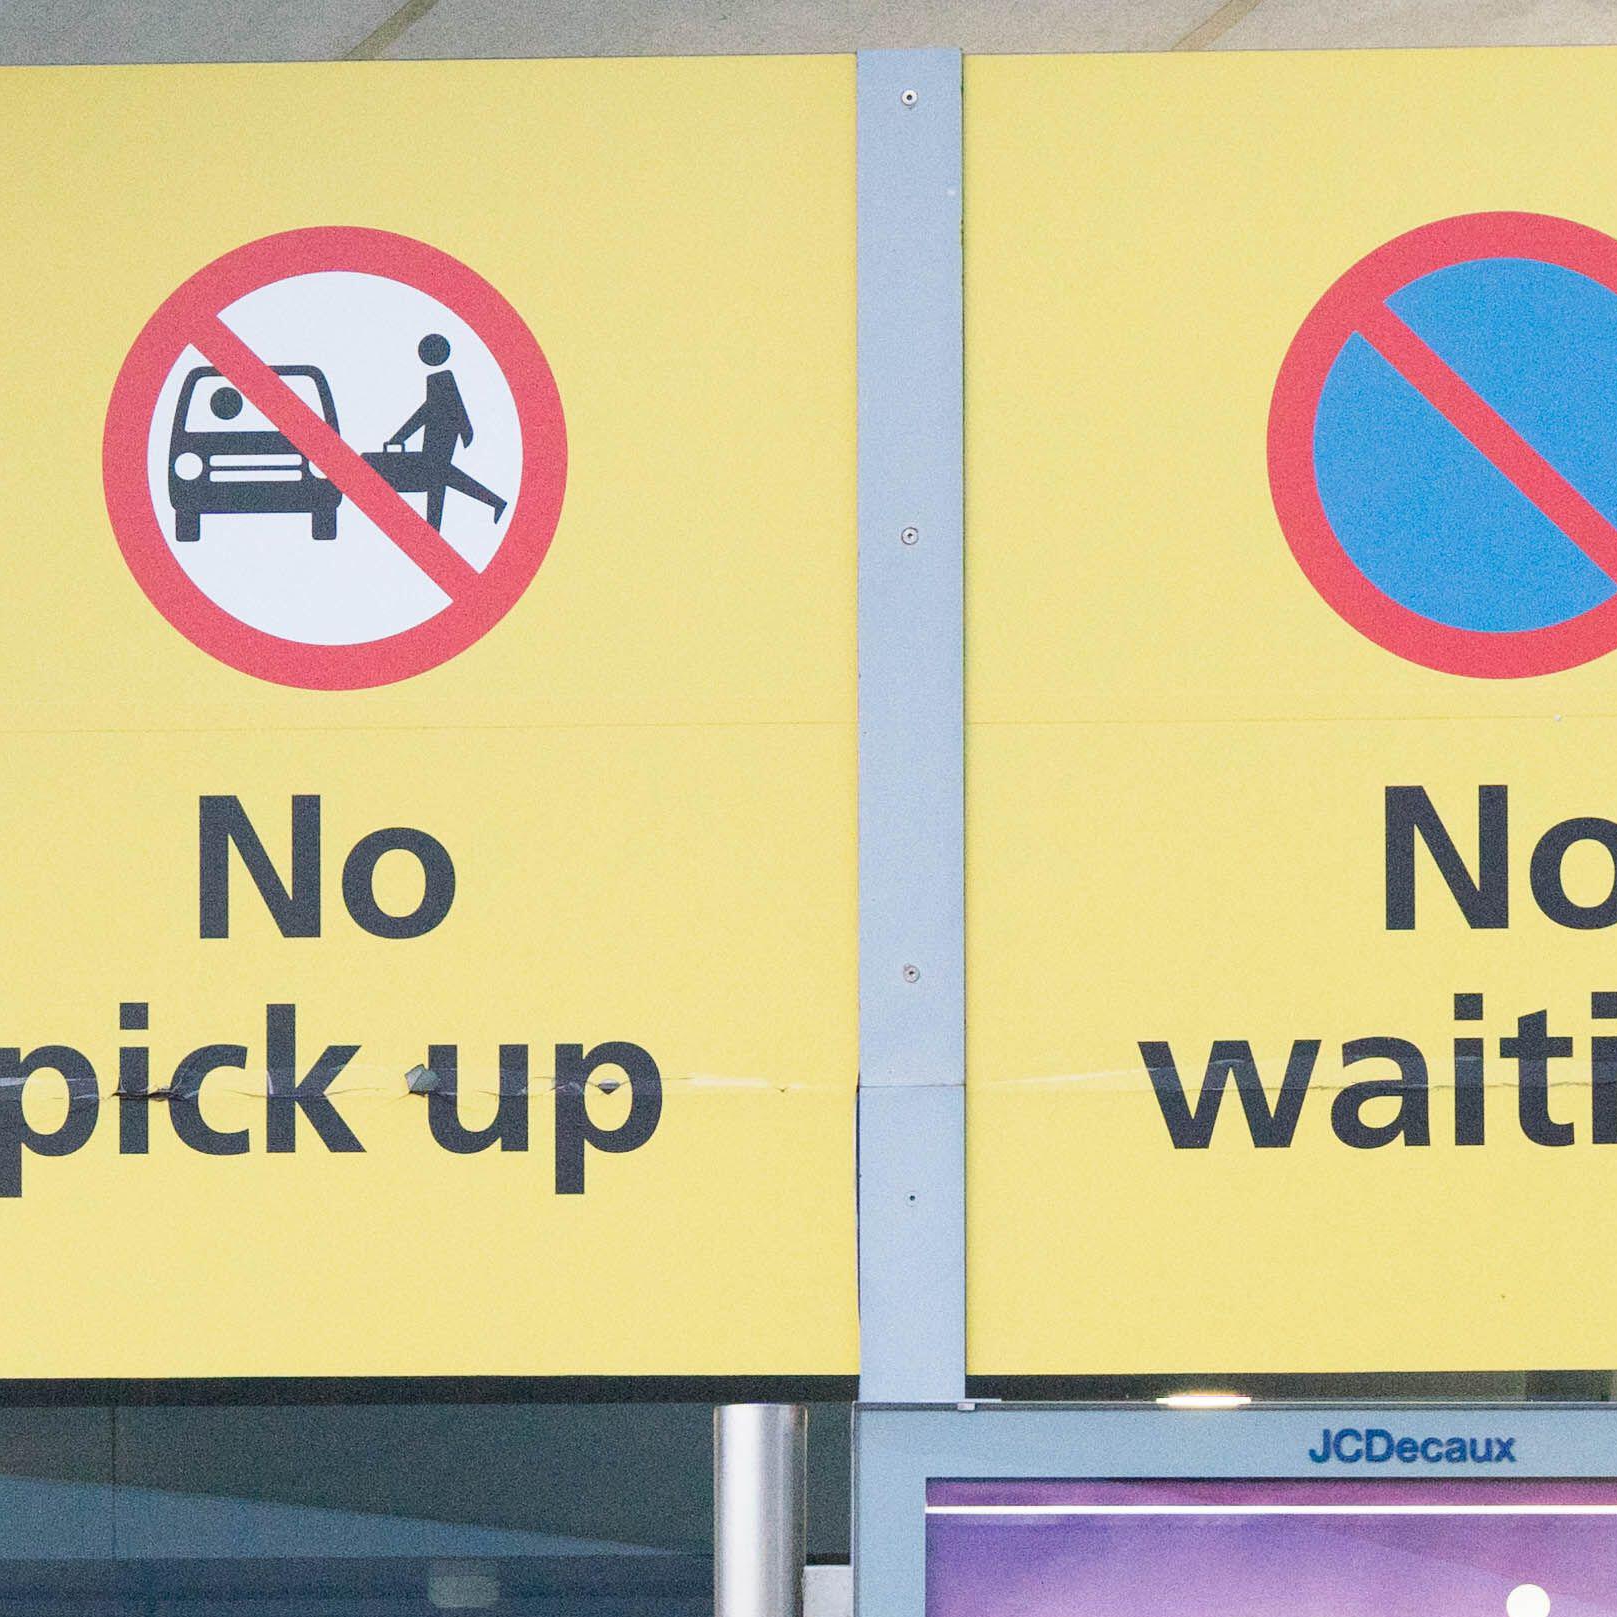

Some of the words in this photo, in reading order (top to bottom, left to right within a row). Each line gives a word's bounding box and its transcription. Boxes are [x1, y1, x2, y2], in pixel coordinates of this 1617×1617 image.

[199, 794, 455, 939] No
[426, 1041, 662, 1194] up
[1309, 1428, 1516, 1463] JCDecaux
